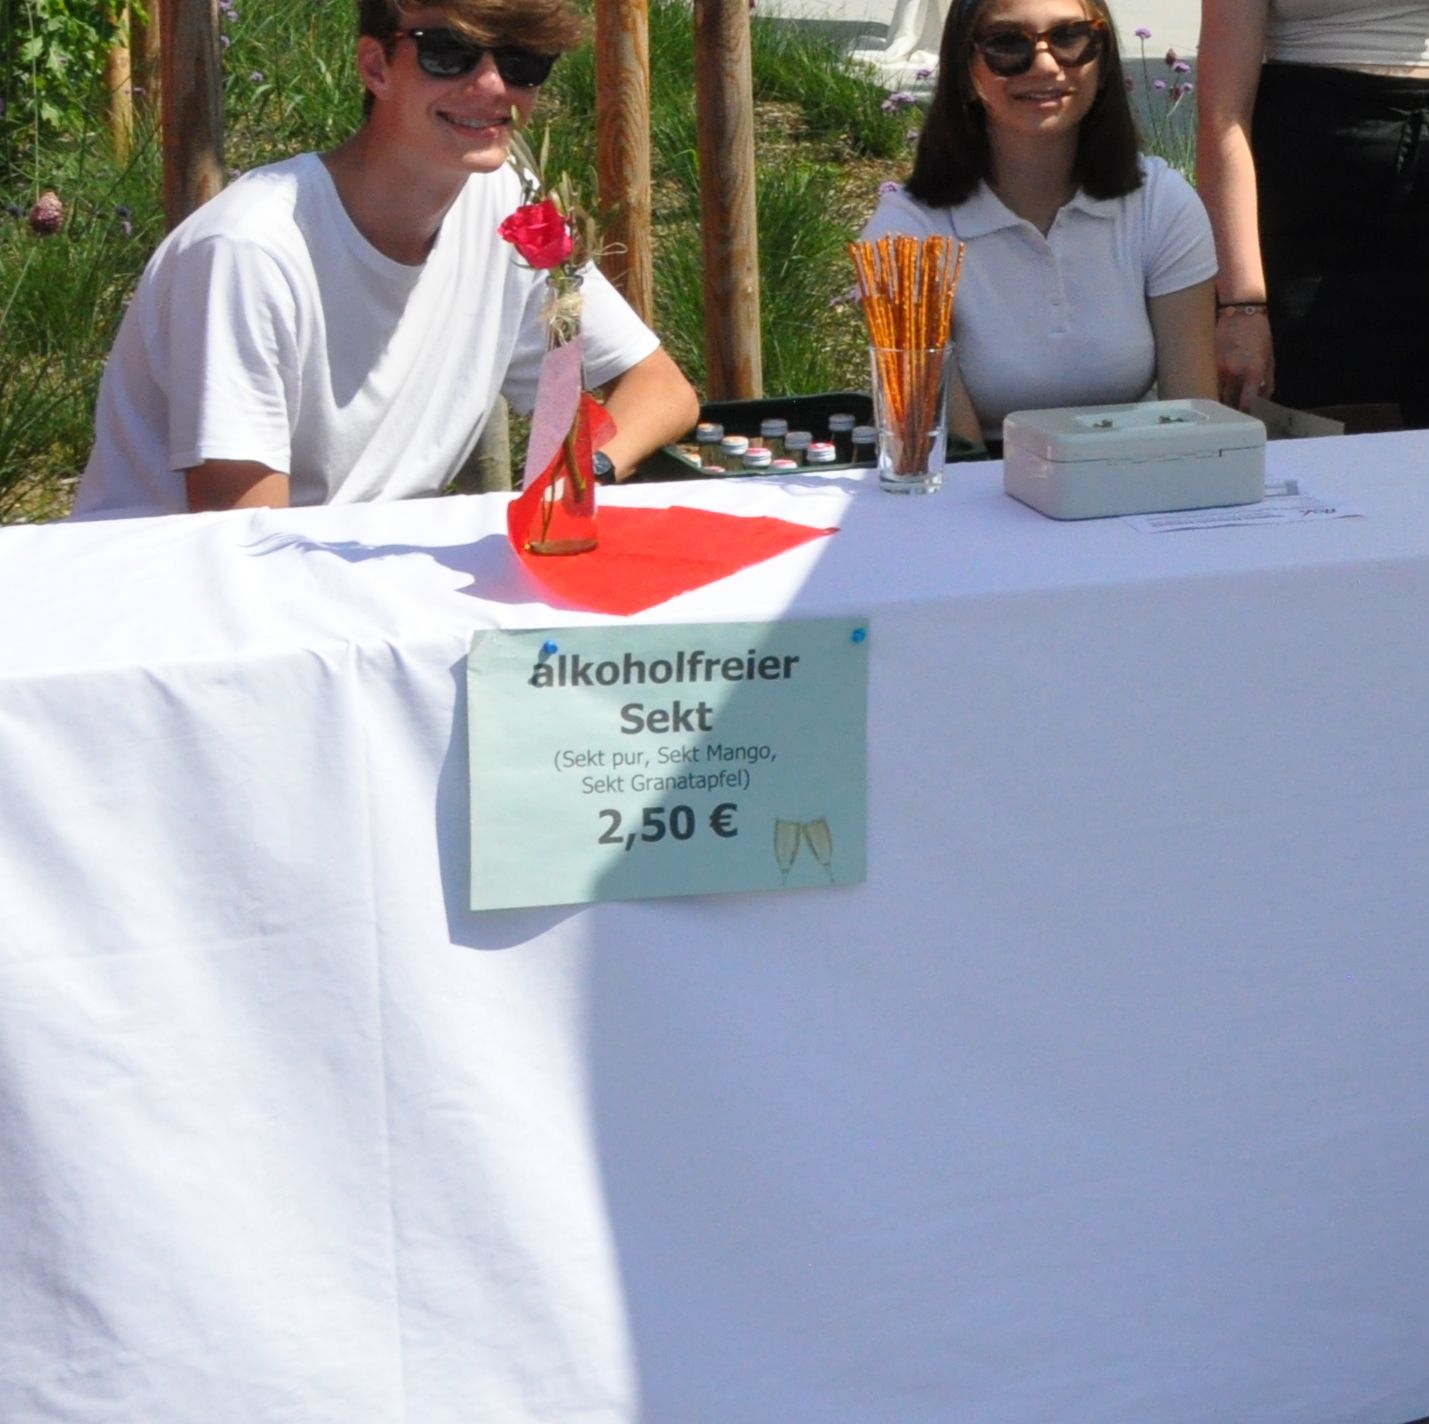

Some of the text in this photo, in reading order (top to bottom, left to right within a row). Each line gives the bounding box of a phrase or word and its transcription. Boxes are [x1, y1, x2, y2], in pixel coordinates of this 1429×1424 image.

[533, 649, 800, 689] alkoholfreier
[619, 700, 714, 735] Sekt
[553, 744, 777, 773] (Sekt pur, Sekt Mango,
[582, 768, 751, 795] Sekt Granatapfel)
[597, 802, 739, 852] 2,50 €
